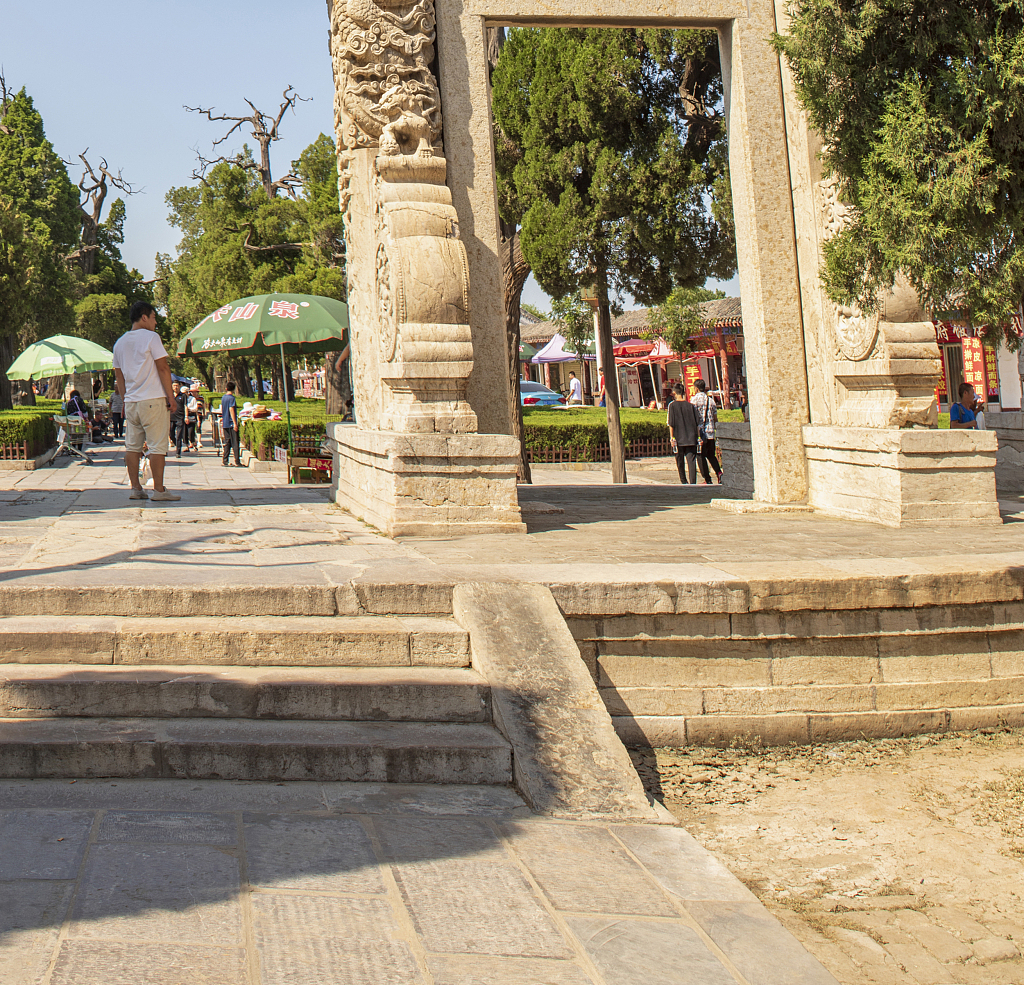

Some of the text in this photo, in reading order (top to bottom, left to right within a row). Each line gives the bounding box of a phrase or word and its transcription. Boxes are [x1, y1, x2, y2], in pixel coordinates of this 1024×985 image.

[191, 300, 300, 333] 夫山泉
[963, 338, 974, 384] 手擀鲜面
